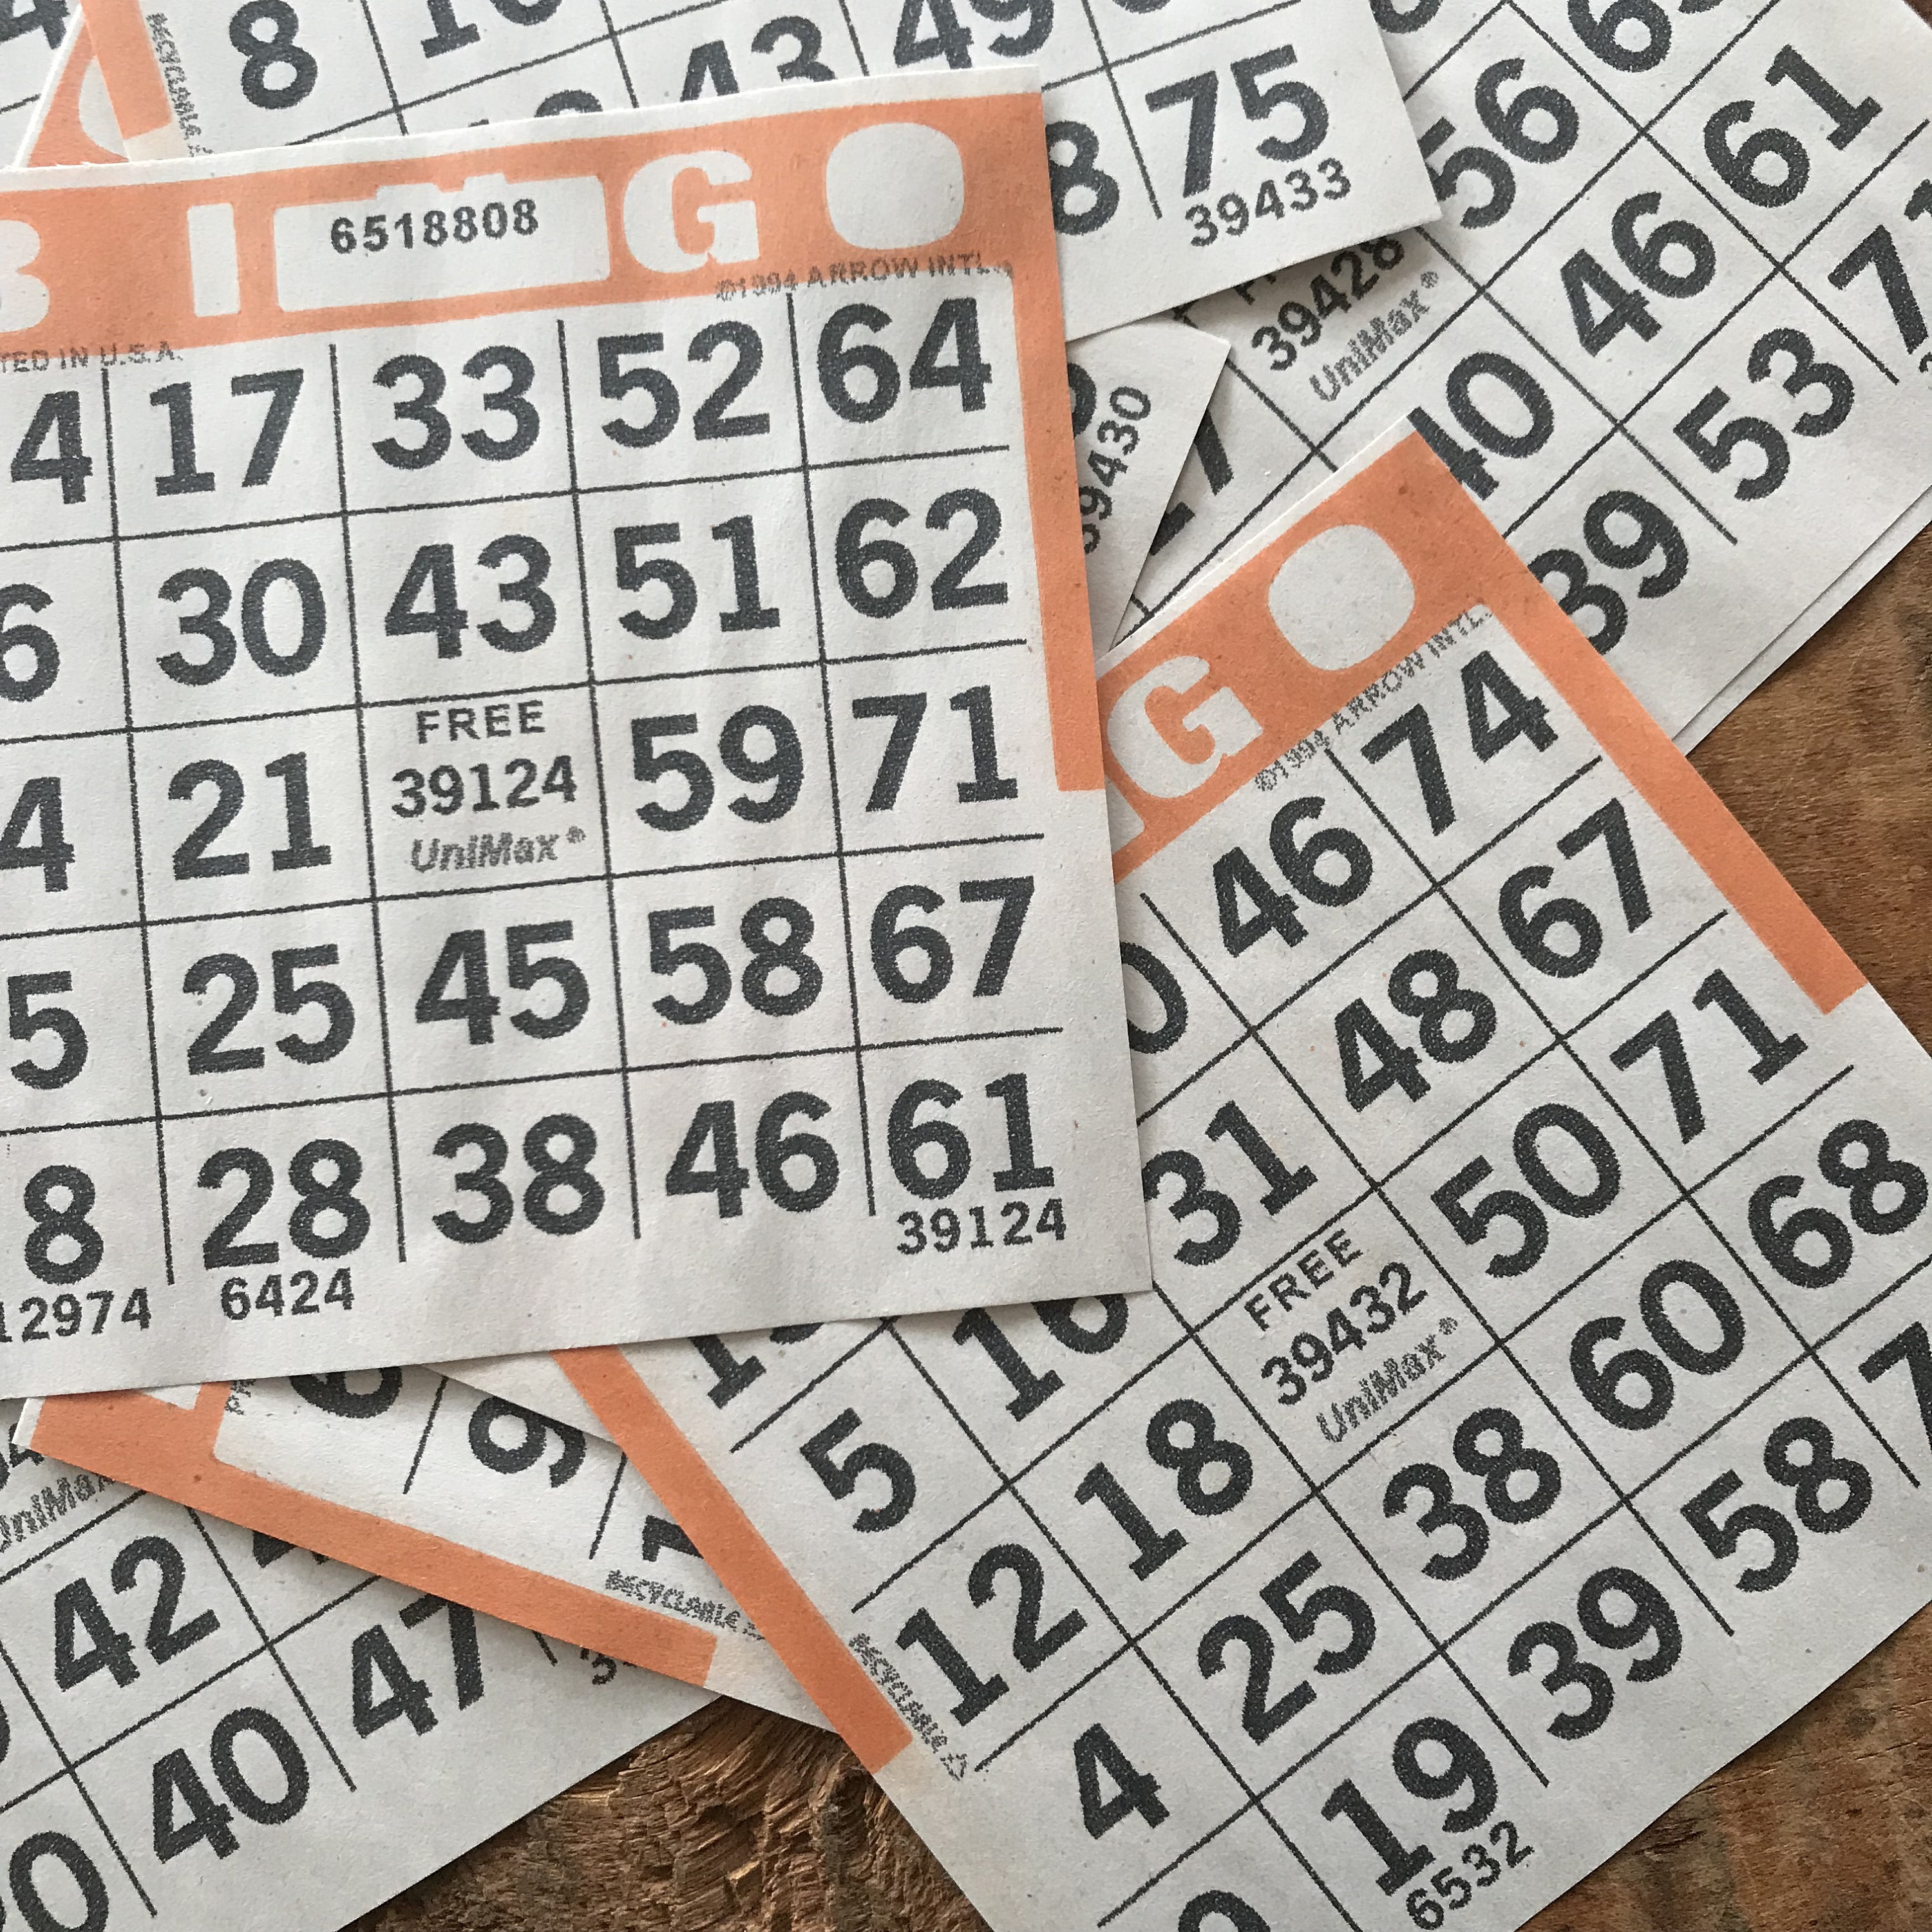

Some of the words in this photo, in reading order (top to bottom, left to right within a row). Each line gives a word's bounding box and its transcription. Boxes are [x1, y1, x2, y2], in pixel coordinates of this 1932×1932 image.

[229, 0, 317, 109] 8
[1146, 45, 1329, 198] 75
[1417, 58, 1579, 229] 56
[1703, 44, 1882, 208] 61
[331, 199, 538, 254] 6518808
[1186, 158, 1350, 246] 39433
[1560, 191, 1716, 357] 46
[372, 346, 539, 469] 33
[598, 321, 770, 448] 52
[817, 298, 992, 424] 64
[1673, 328, 1855, 501] 53
[150, 369, 303, 496] 17
[385, 535, 556, 659] 43
[614, 515, 780, 639] 51
[835, 488, 1008, 618] 62
[1528, 490, 1689, 656] 39
[156, 558, 326, 687] 30
[392, 755, 576, 818] 39124
[417, 700, 544, 744] FREE
[630, 705, 804, 831] 59
[852, 685, 1018, 812] 71
[1361, 650, 1558, 836] 74
[168, 752, 331, 880] 21
[1213, 797, 1373, 958] 46
[870, 876, 1034, 1003] 67
[1499, 798, 1652, 978] 67
[183, 944, 355, 1075] 25
[415, 920, 589, 1045] 45
[649, 896, 823, 1025] 58
[1334, 949, 1497, 1113] 48
[1609, 969, 1808, 1144] 71
[432, 1114, 605, 1244] 38
[666, 1092, 840, 1218] 46
[887, 1073, 1055, 1200] 61
[1141, 1100, 1318, 1266] 31
[1430, 1103, 1622, 1278] 50
[198, 1139, 370, 1270] 28
[897, 1198, 1066, 1255] 39124
[1748, 1119, 1929, 1289] 68
[220, 1267, 354, 1320] 6424
[1244, 1229, 1363, 1331] FREE
[1261, 1262, 1428, 1405] 39432
[1569, 1260, 1746, 1431] 60
[799, 1408, 916, 1533] 5
[1074, 1398, 1253, 1581] 18
[1383, 1407, 1562, 1581] 38
[1680, 1417, 1873, 1593] 58
[54, 1536, 220, 1692] 42
[352, 1591, 484, 1739] 47
[895, 1544, 1087, 1732] 12
[1197, 1551, 1376, 1746] 25
[1507, 1566, 1682, 1741] 39
[152, 1707, 310, 1864] 40
[1073, 1723, 1170, 1839] 4
[1321, 1717, 1501, 1897] 19
[1406, 1820, 1535, 1930] 6532
